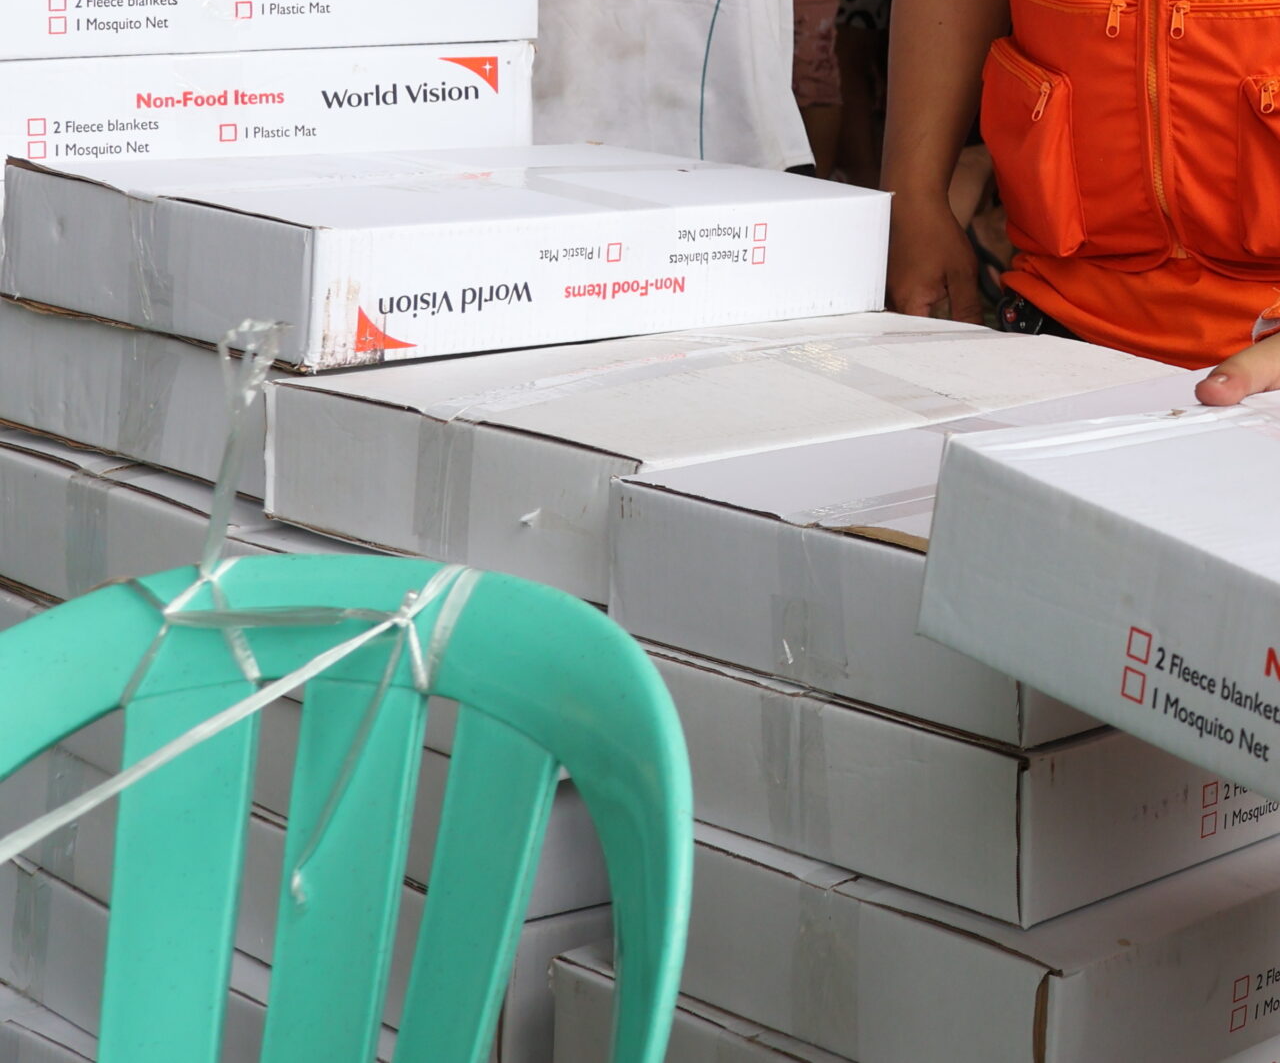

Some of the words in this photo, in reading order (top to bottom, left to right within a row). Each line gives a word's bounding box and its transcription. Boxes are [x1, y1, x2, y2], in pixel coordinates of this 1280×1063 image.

[269, 3, 305, 15] Plastic
[309, 2, 330, 13] Mat
[86, 18, 141, 33] Mosquito
[146, 16, 168, 28] Net
[136, 90, 228, 108] Non-Food
[234, 89, 284, 105] Items
[321, 83, 397, 109] World
[405, 81, 480, 103] Vision
[52, 120, 62, 135] 2
[65, 121, 103, 133] Fleece
[108, 118, 159, 131] blankets
[253, 126, 290, 138] Plastic
[294, 125, 316, 137] Mat
[65, 143, 122, 158] Mosquito
[126, 141, 149, 153] Net
[678, 230, 696, 242] Net
[699, 224, 741, 239] Mosquito
[540, 249, 559, 262] Mat
[562, 247, 594, 260] Plastic
[669, 252, 708, 265] blankets
[712, 250, 739, 262] Fleece
[741, 248, 749, 263] 2
[565, 283, 607, 300] Items
[611, 276, 685, 299] Non-Food
[379, 291, 453, 318] Vision
[461, 282, 532, 313] World
[1154, 646, 1166, 672] 2
[1169, 653, 1216, 694] Fleece
[1164, 693, 1234, 744] Mosquito
[1239, 728, 1269, 762] Net
[1223, 783, 1231, 800] 2
[1231, 800, 1279, 826] Mosquito
[1255, 974, 1265, 992] 2
